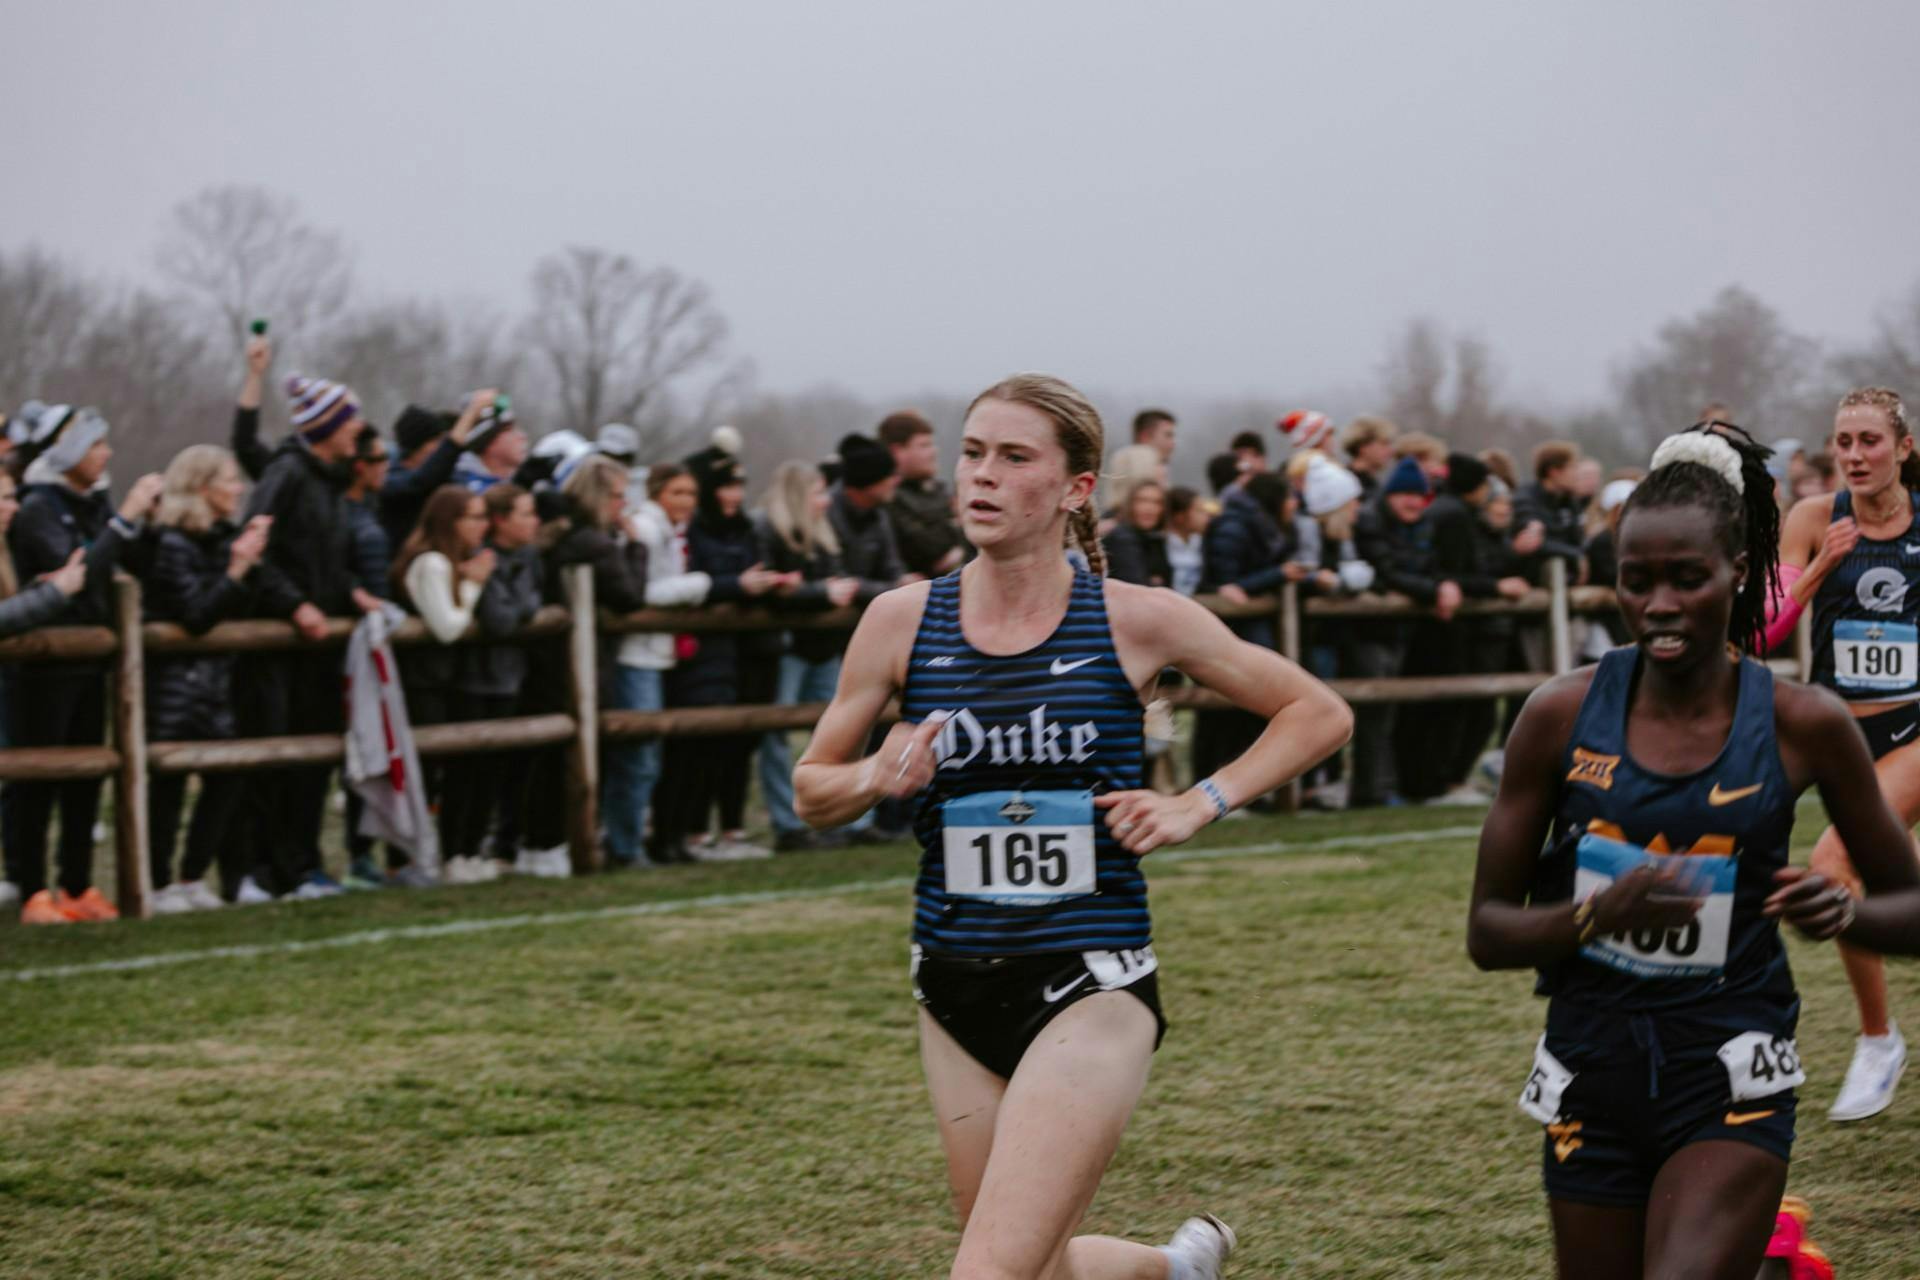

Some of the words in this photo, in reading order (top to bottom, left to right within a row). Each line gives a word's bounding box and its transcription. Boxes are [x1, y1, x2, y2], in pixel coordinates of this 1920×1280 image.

[1848, 645, 1902, 676] 190
[930, 703, 1100, 770] Duke
[972, 833, 1068, 887] 165
[1750, 1037, 1801, 1082] 48
